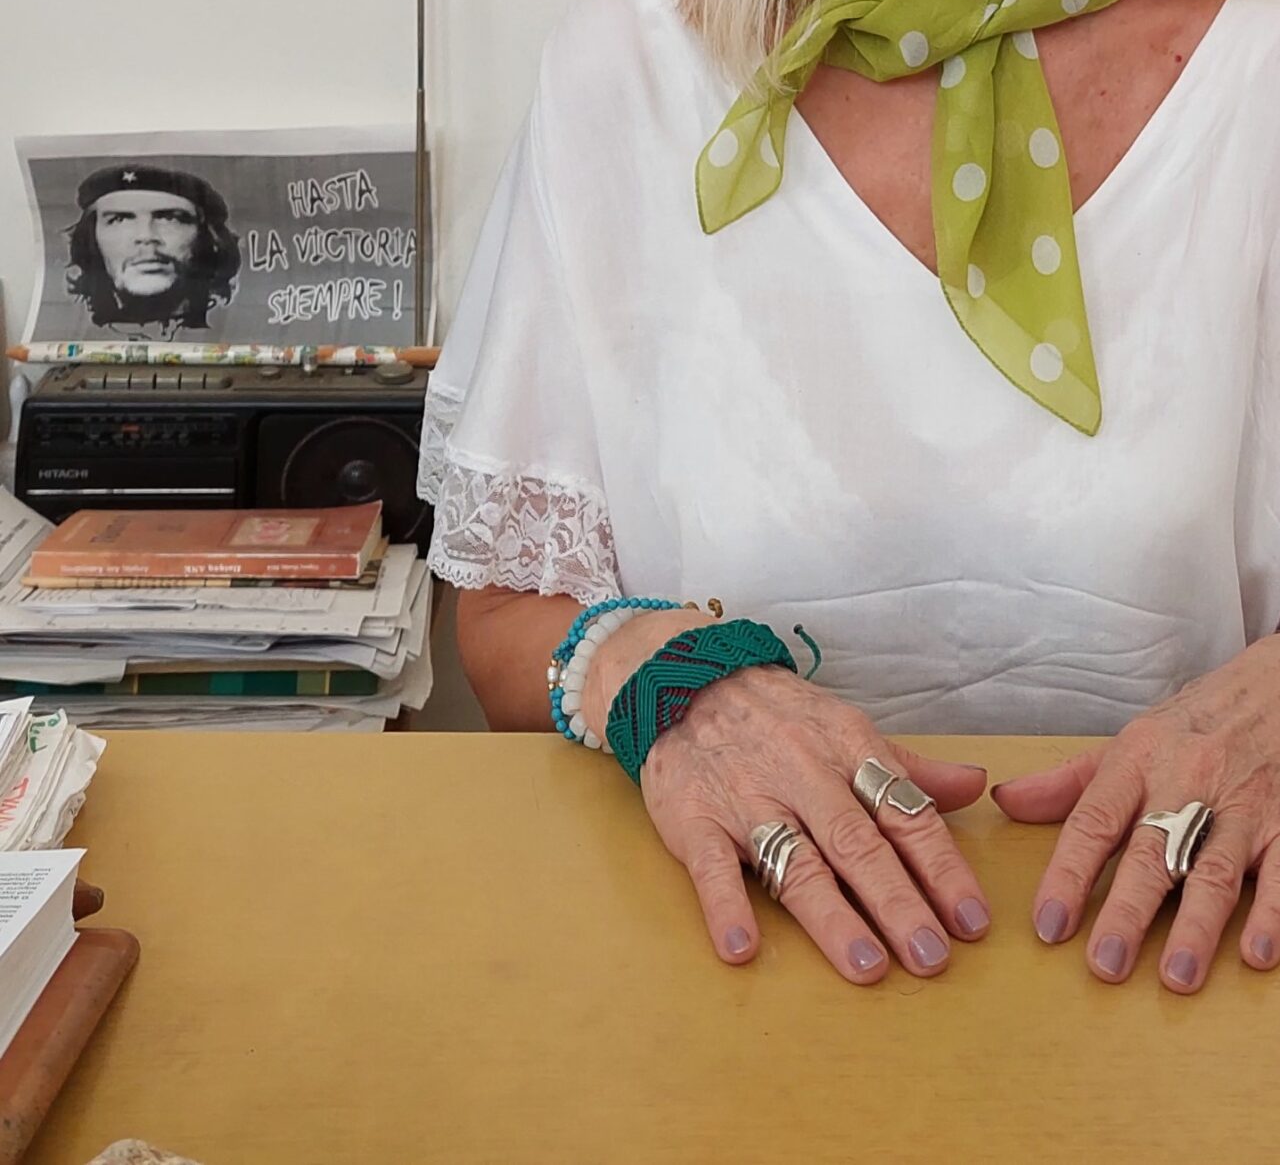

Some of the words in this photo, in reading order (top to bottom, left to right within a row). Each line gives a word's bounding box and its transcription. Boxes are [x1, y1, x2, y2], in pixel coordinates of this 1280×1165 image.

[288, 169, 379, 219] HASTA
[248, 230, 289, 272] LA
[295, 227, 417, 268] VICTORIA
[39, 468, 88, 479] HITACHI
